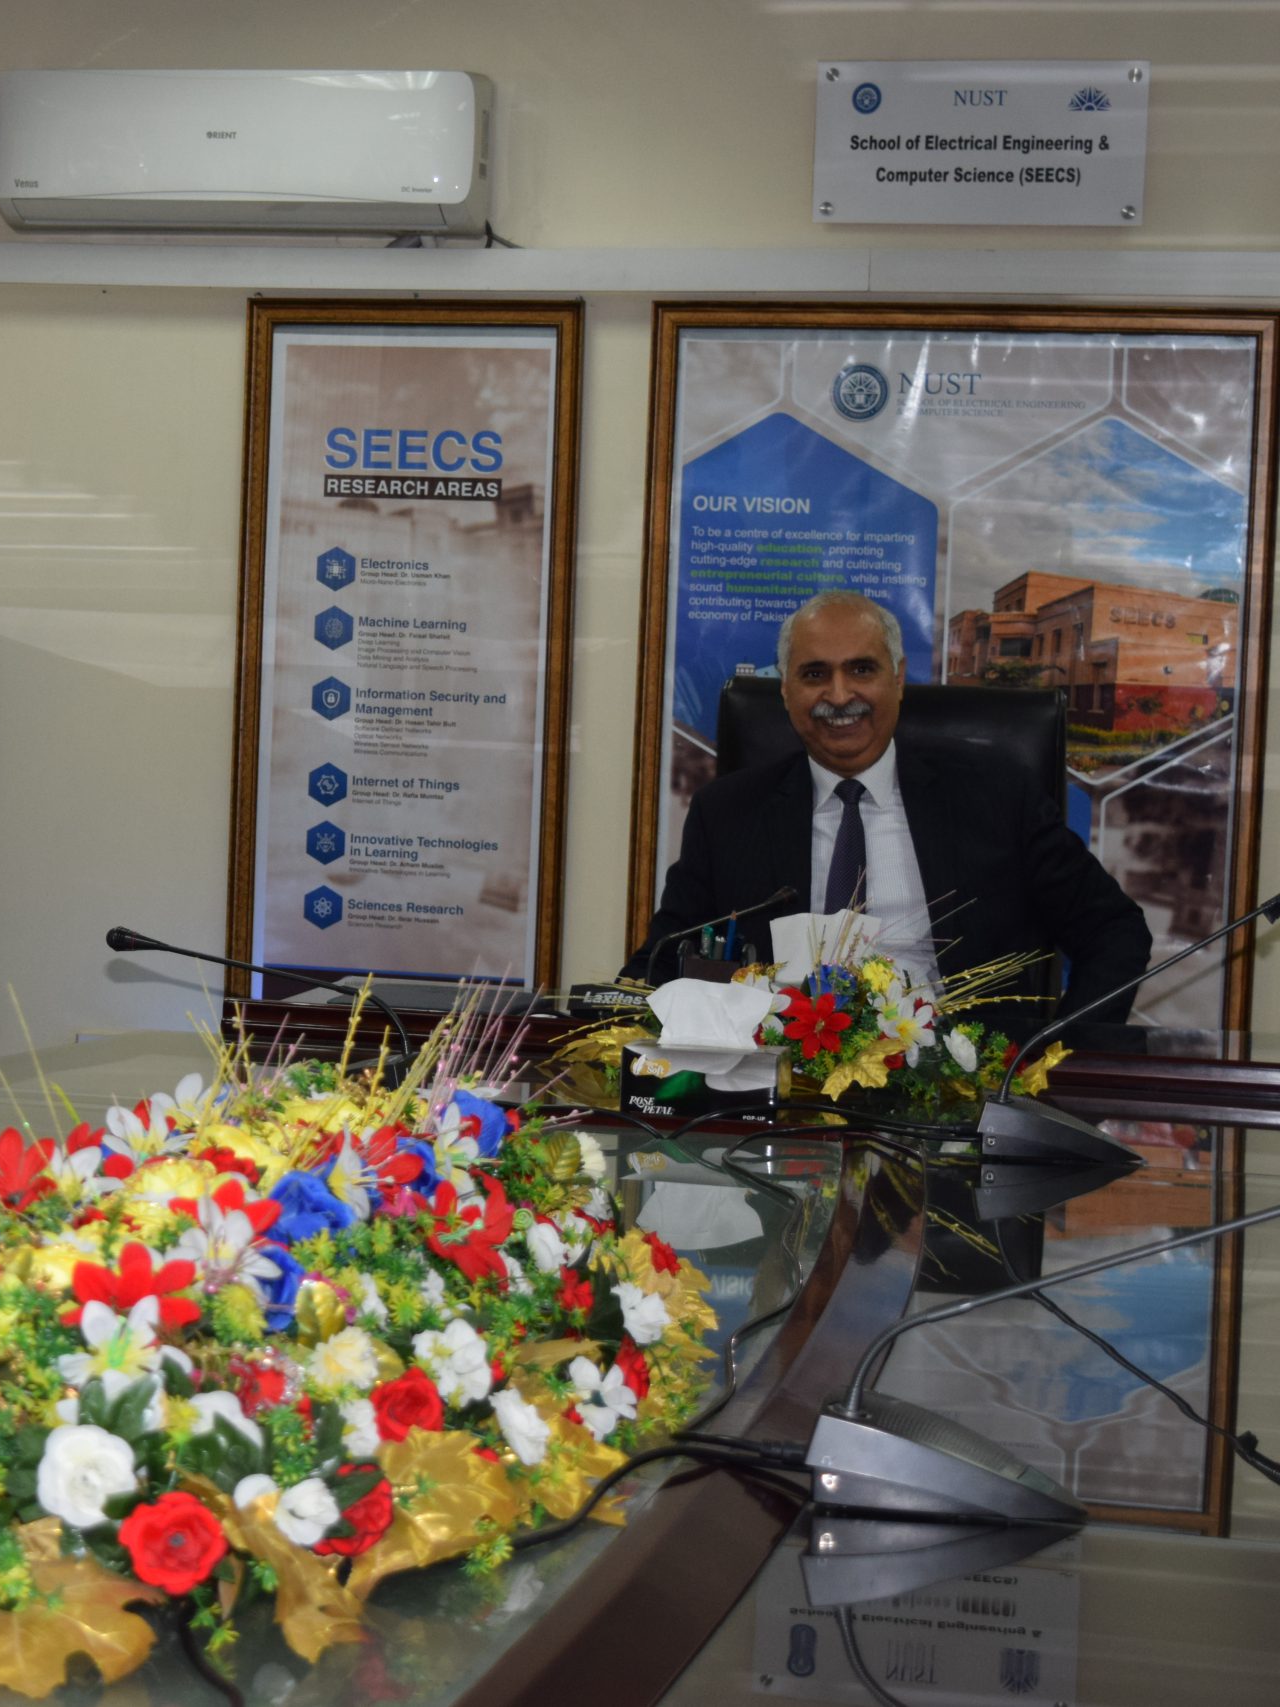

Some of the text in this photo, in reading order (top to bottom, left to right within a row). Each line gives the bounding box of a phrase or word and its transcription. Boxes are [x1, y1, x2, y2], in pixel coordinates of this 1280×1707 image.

[953, 90, 1008, 106] NUST
[206, 131, 237, 139] ORIENT
[850, 134, 1110, 155] School of Electrical Engineering &
[14, 178, 39, 188] Venus
[876, 166, 1082, 186] Computer Science (SEECS)
[898, 372, 982, 395] NUST
[324, 427, 504, 473] SEECS
[326, 478, 499, 498] RESEARCH AREAS
[692, 496, 810, 514] OUR VISION
[692, 526, 915, 545] To be a centre of excellence for imparting
[691, 540, 754, 554] high-quality
[828, 545, 884, 558] promoting
[360, 558, 429, 570] Electronics
[690, 554, 902, 572] cutting-edge research and cultivating
[690, 568, 793, 582] entrepreneurial
[851, 574, 880, 584] while
[689, 582, 723, 593] sound
[726, 583, 814, 596] humanitarian
[688, 596, 752, 610] contributing
[754, 598, 798, 608] towards
[358, 616, 468, 632] Machine Learning
[688, 611, 738, 624] economy
[740, 611, 752, 622] of
[356, 688, 506, 705] Information Security and
[356, 704, 433, 717] Management
[352, 776, 460, 792] Internet of Things
[350, 834, 498, 851] Innovative Technologies
[350, 846, 418, 862] in Learning
[348, 899, 464, 914] Sciences Research
[646, 1064, 664, 1076] Soft
[628, 1095, 655, 1108] ROSE
[642, 1105, 673, 1116] PETAL
